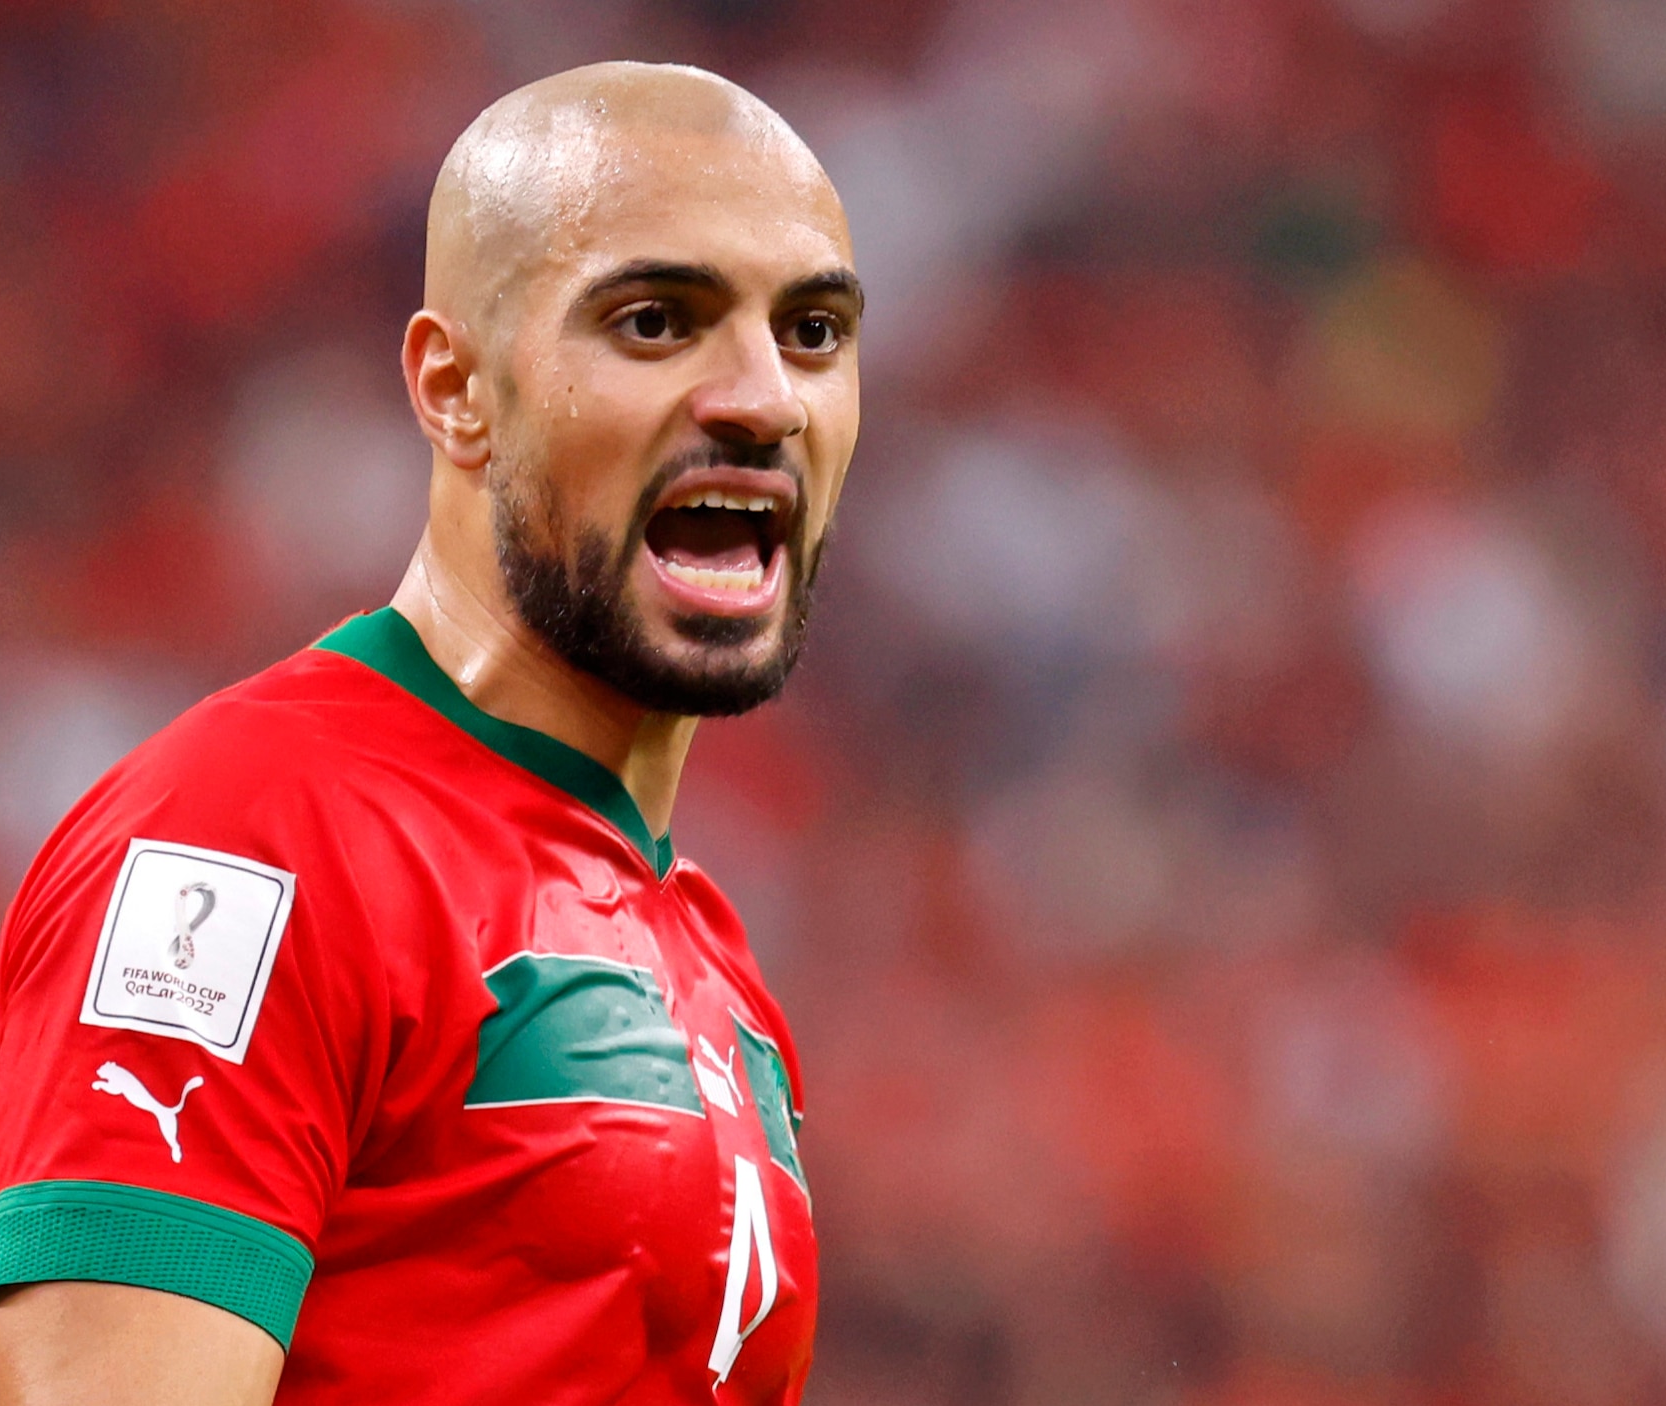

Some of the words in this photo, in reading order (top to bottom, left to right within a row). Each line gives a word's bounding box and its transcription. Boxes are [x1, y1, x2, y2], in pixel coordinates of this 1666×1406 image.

[122, 967, 149, 980] FIFA
[151, 970, 197, 994] WORLD
[199, 987, 226, 1002] CUP
